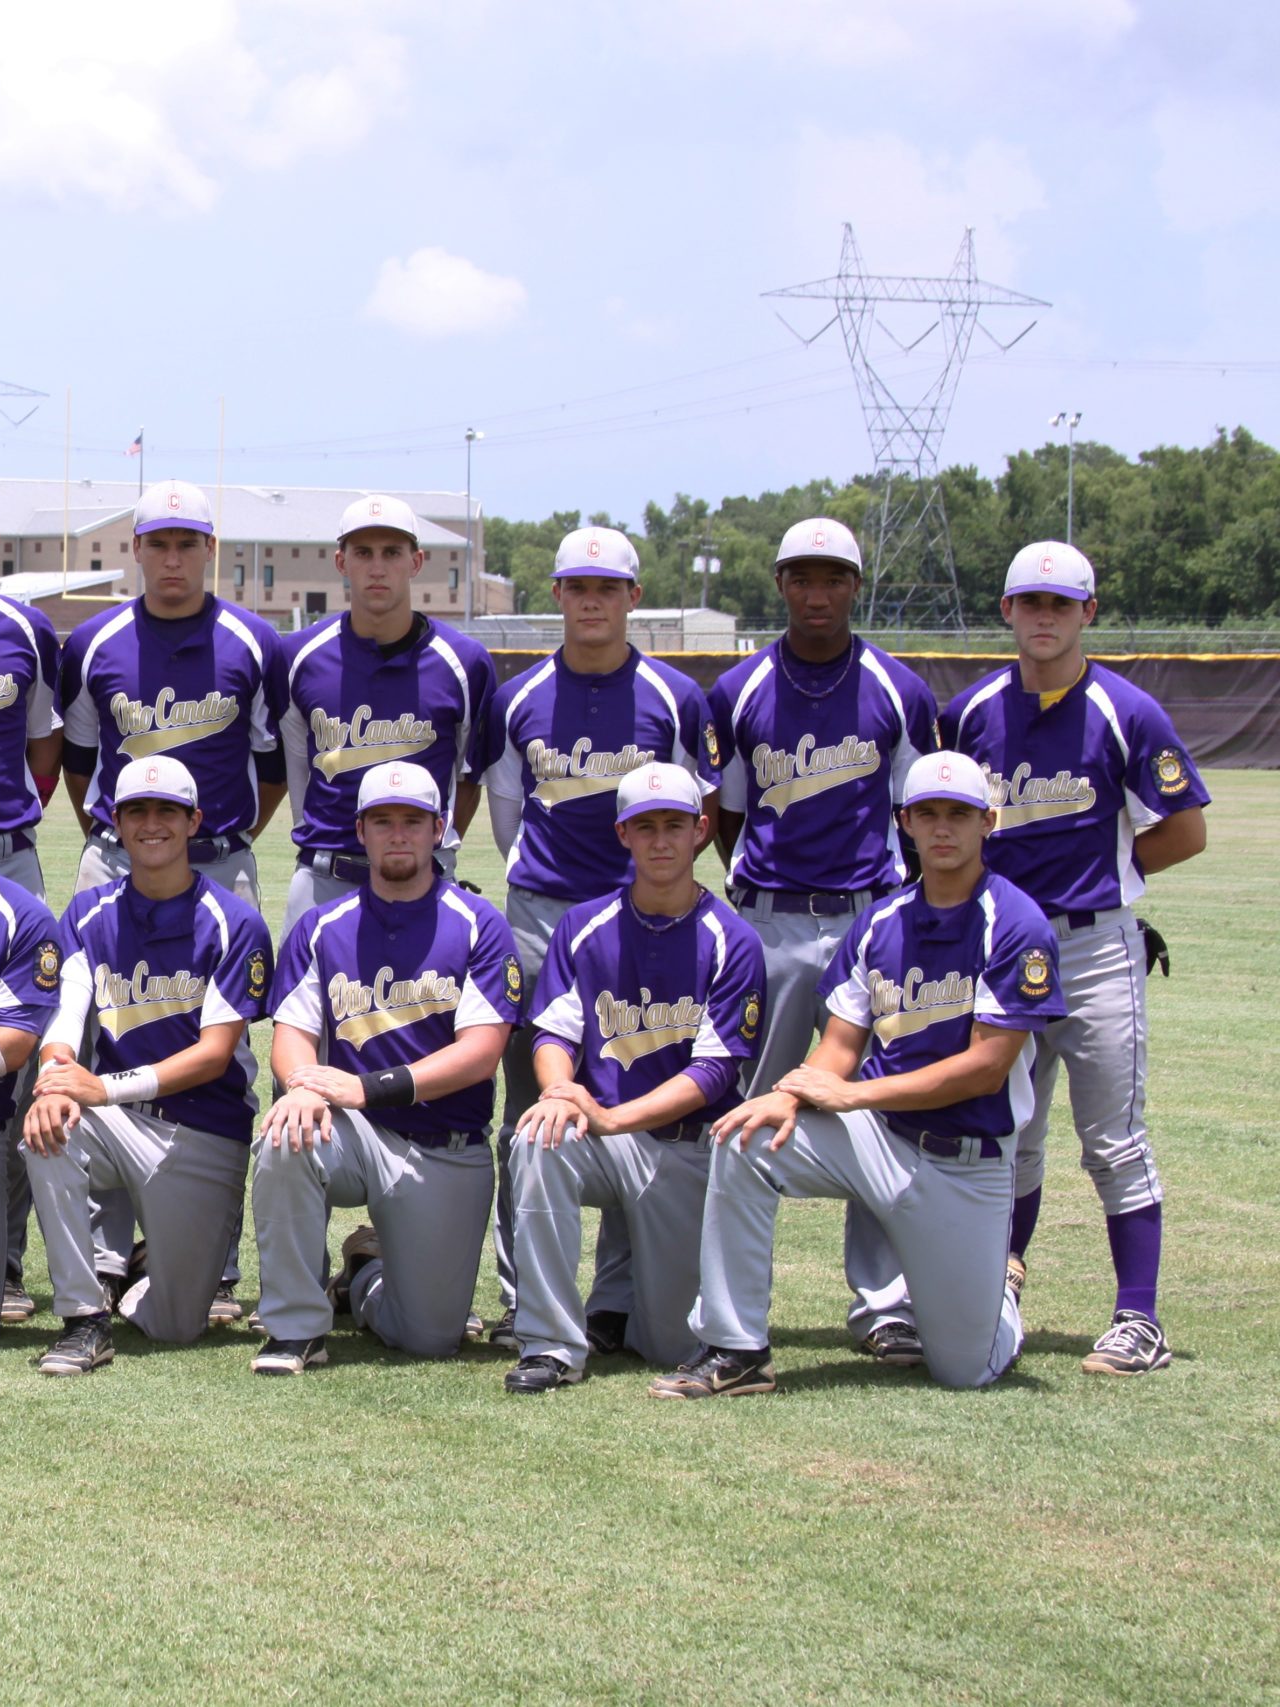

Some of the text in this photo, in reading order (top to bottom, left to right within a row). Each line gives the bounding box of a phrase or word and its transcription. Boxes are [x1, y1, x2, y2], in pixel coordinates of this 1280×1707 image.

[168, 493, 180, 509] C
[369, 500, 381, 517] C
[813, 531, 825, 548] C
[587, 541, 599, 557] C
[1040, 557, 1052, 573] C
[110, 687, 238, 735] Otto Candies
[310, 704, 436, 752] Otto Candies
[527, 738, 571, 782] Otto
[796, 733, 879, 777] Candies
[146, 766, 158, 782] C
[389, 771, 401, 787] C
[938, 765, 950, 781] C
[649, 774, 661, 791] C
[1010, 762, 1094, 804] Candies
[95, 963, 131, 1008] Otto
[328, 966, 462, 1020] Otto Candies
[595, 990, 641, 1038] Otto
